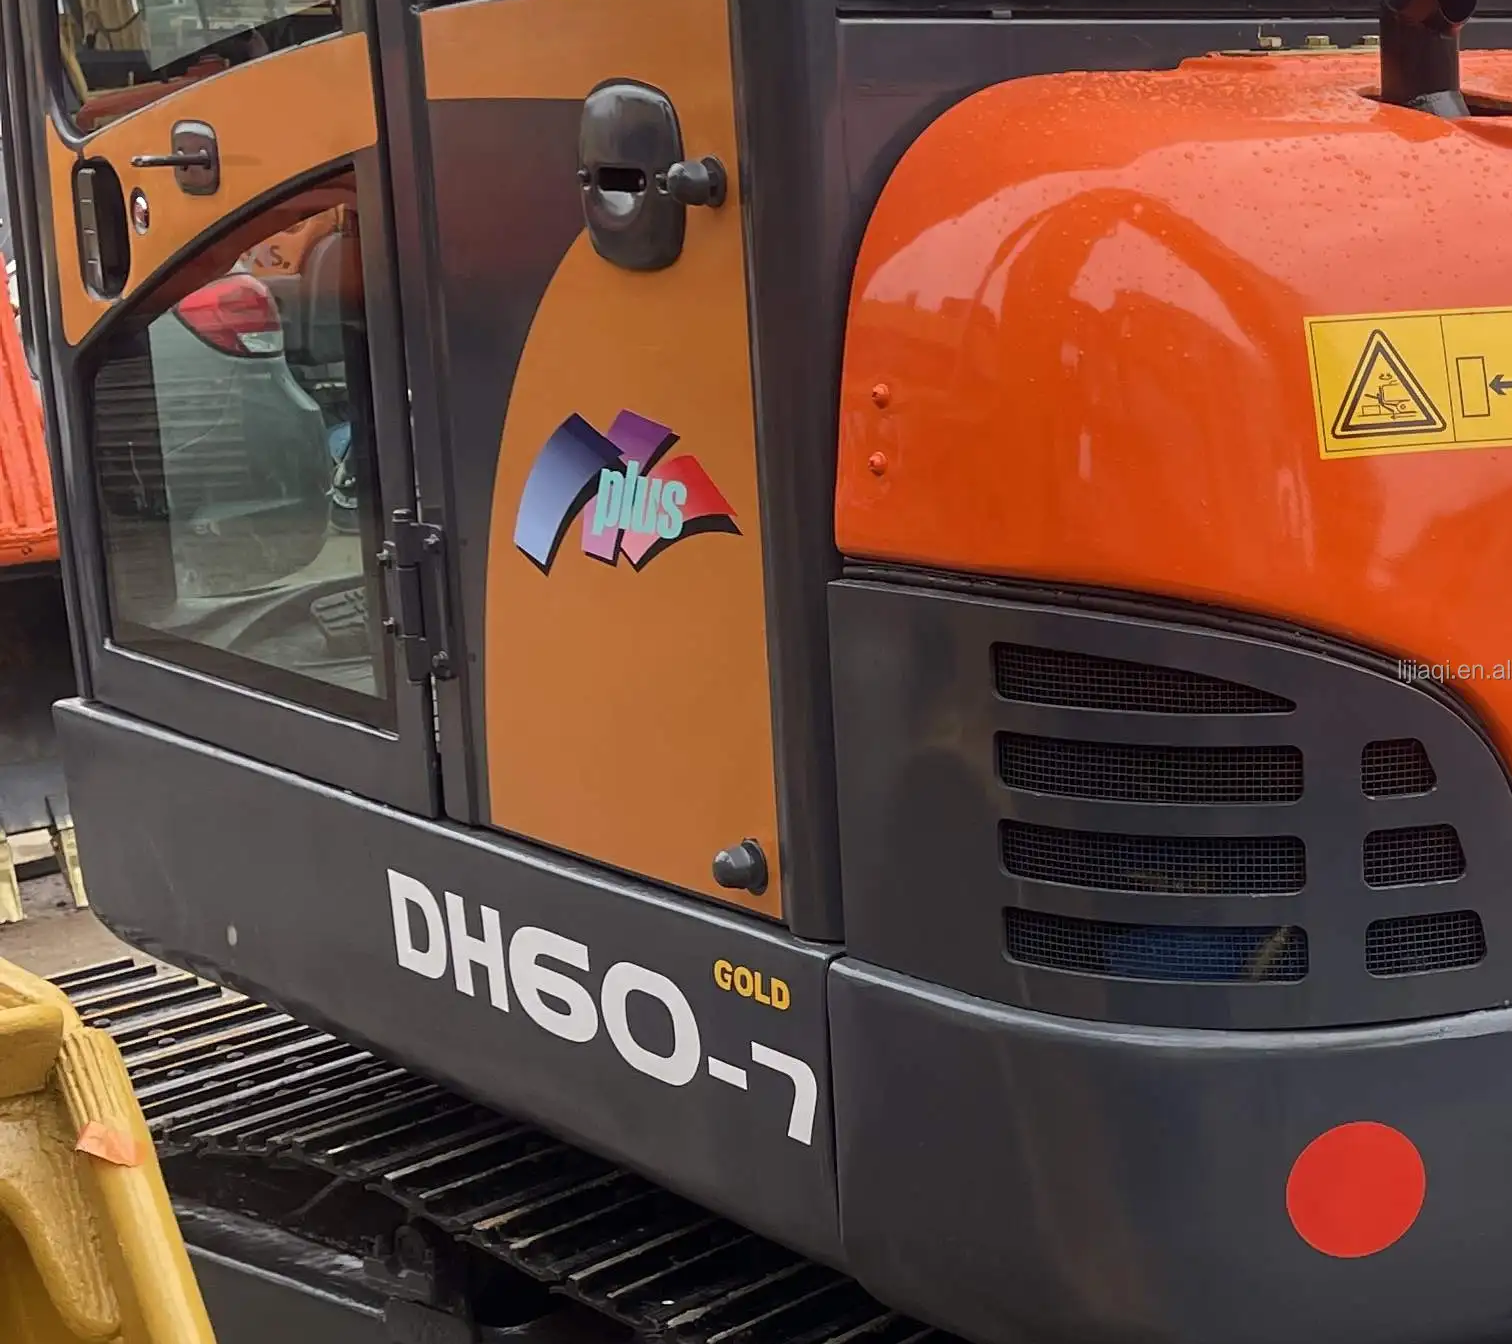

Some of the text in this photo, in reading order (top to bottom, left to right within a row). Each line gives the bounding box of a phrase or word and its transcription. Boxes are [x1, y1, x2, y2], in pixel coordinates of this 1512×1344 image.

[592, 459, 688, 540] plus
[386, 868, 818, 1146] DH60-7
[712, 958, 792, 1012] GOLD
